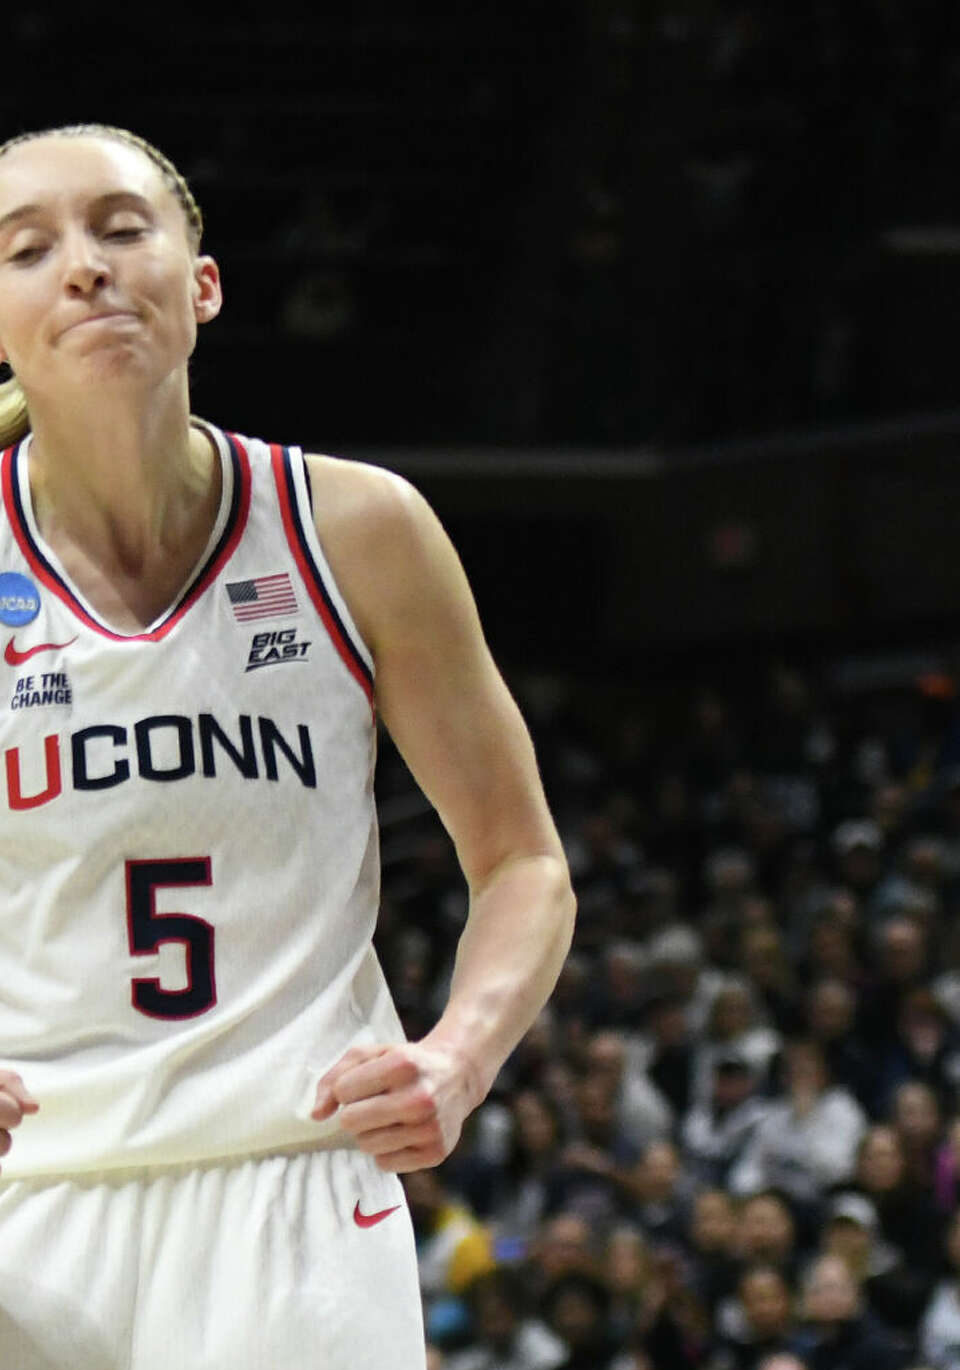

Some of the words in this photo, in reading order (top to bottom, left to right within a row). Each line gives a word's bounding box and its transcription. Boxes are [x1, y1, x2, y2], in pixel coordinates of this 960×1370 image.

[251, 628, 297, 648] BIG
[248, 641, 312, 664] EAST
[15, 676, 34, 694] BE
[40, 672, 68, 690] THE
[11, 689, 72, 710] CHANGE
[5, 713, 317, 811] UCONN
[125, 856, 218, 1021] 5
